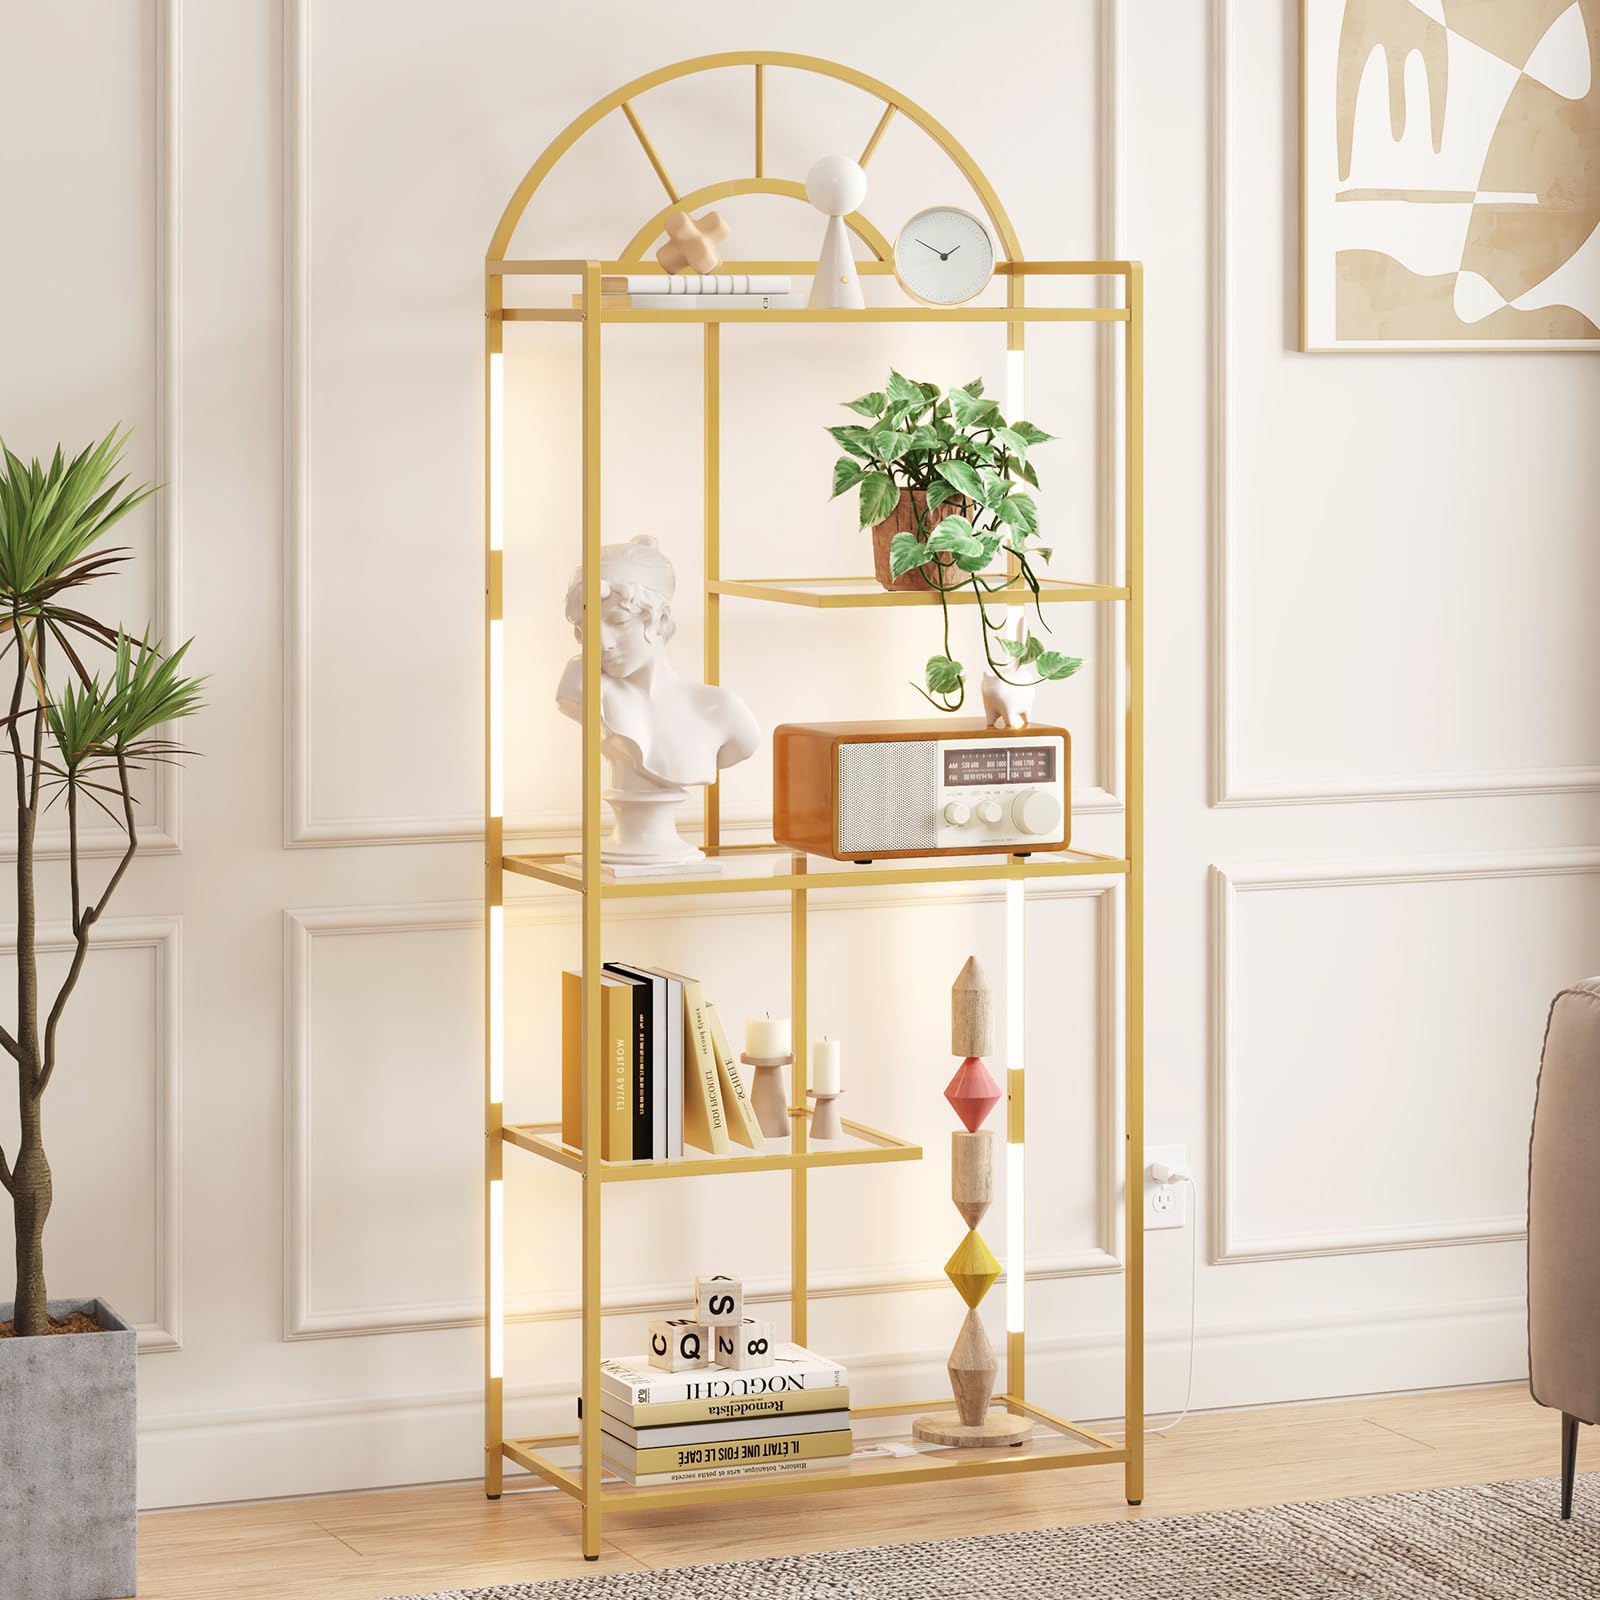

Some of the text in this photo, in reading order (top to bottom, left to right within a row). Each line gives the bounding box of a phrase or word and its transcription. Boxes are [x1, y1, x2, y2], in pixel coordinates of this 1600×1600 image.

[709, 1295, 734, 1315] S
[652, 1333, 667, 1356] C
[680, 1334, 700, 1359] Q
[719, 1336, 734, 1355] 2
[748, 1338, 768, 1355] 8
[686, 1373, 806, 1399] NOGUCHI
[708, 1400, 784, 1416] Remodelista
[678, 1440, 800, 1467] IL ÉTAIT UNE FOIS LE CAFÉ
